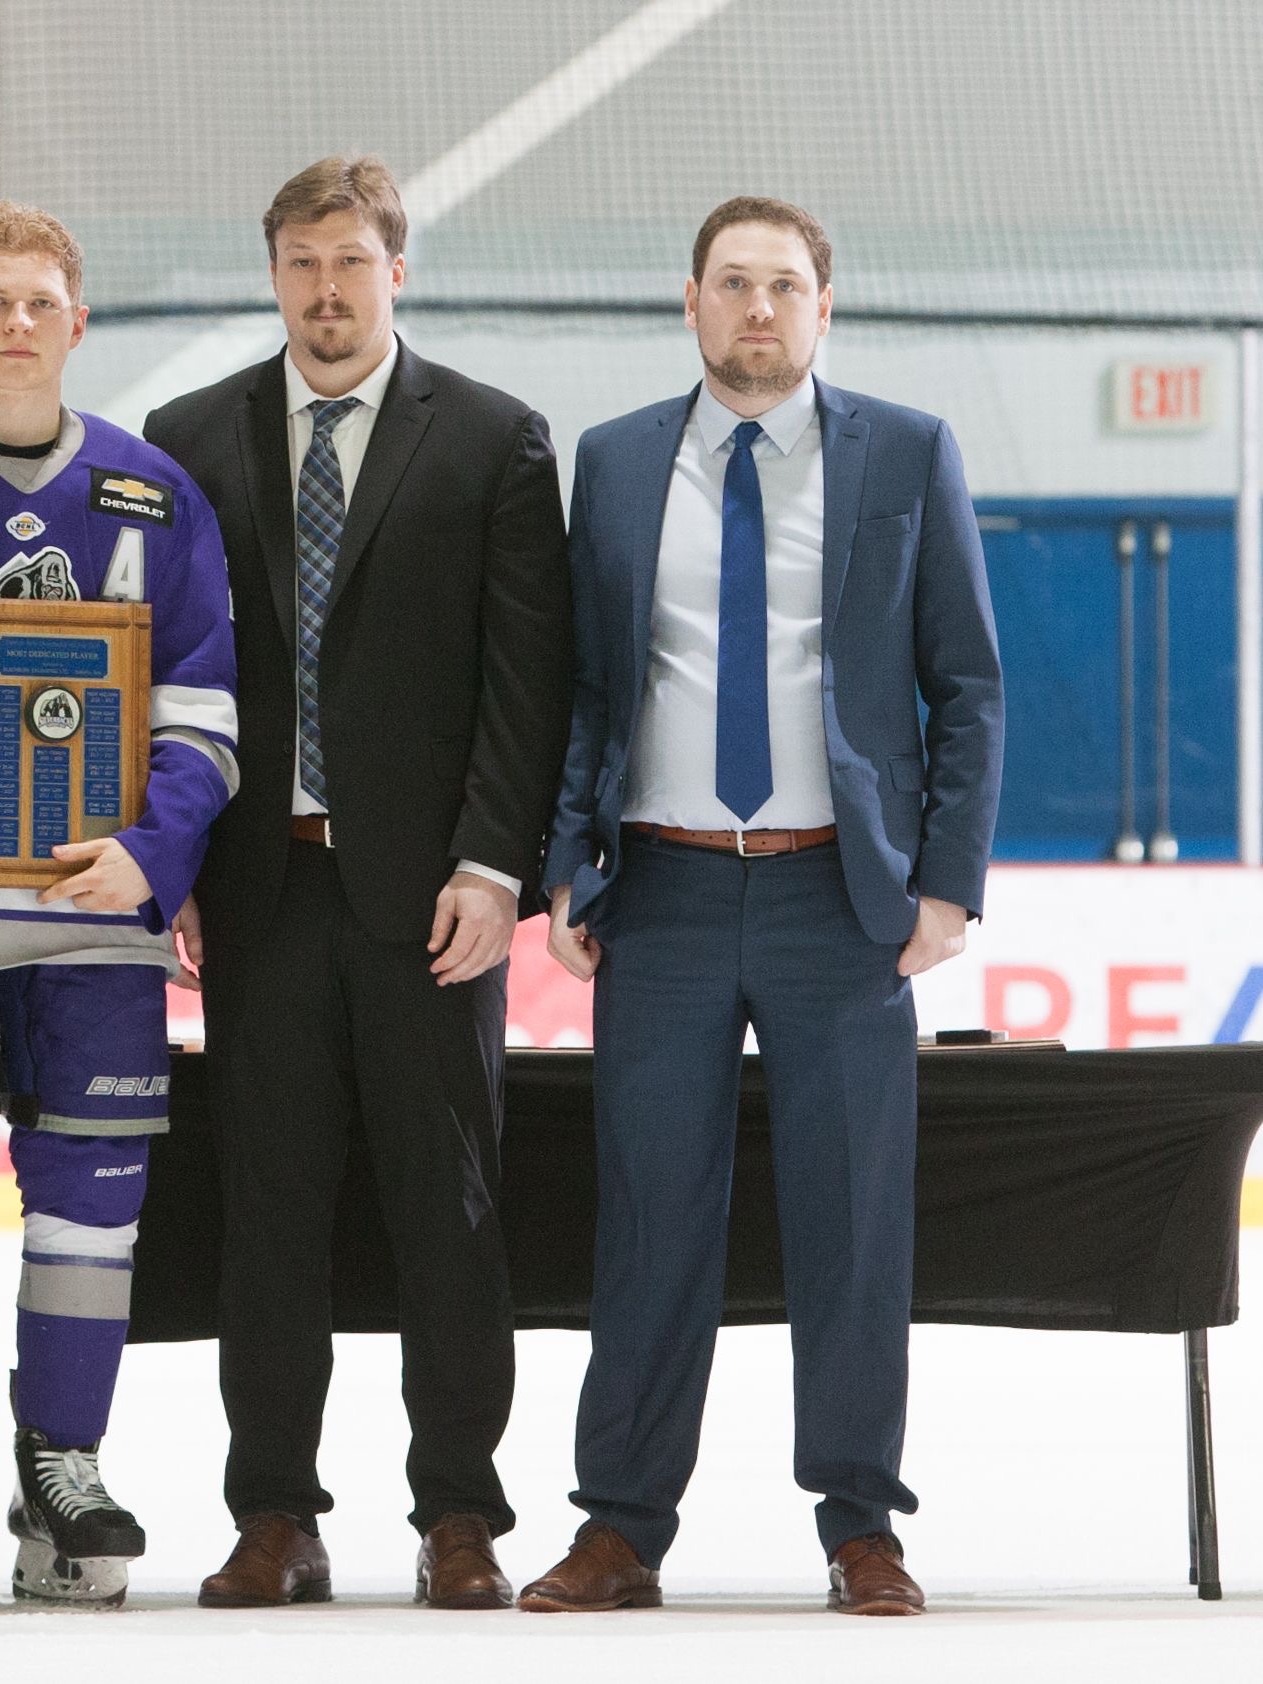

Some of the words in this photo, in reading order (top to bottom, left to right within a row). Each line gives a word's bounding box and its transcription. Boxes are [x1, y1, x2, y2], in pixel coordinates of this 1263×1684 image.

[1131, 366, 1201, 418] EXIT
[100, 497, 166, 518] CHEVROLET
[100, 526, 145, 602] A
[6, 650, 27, 658] MOST
[28, 650, 70, 660] DEDICATED
[70, 651, 99, 661] PLAYER
[85, 1076, 170, 1096] BAUE
